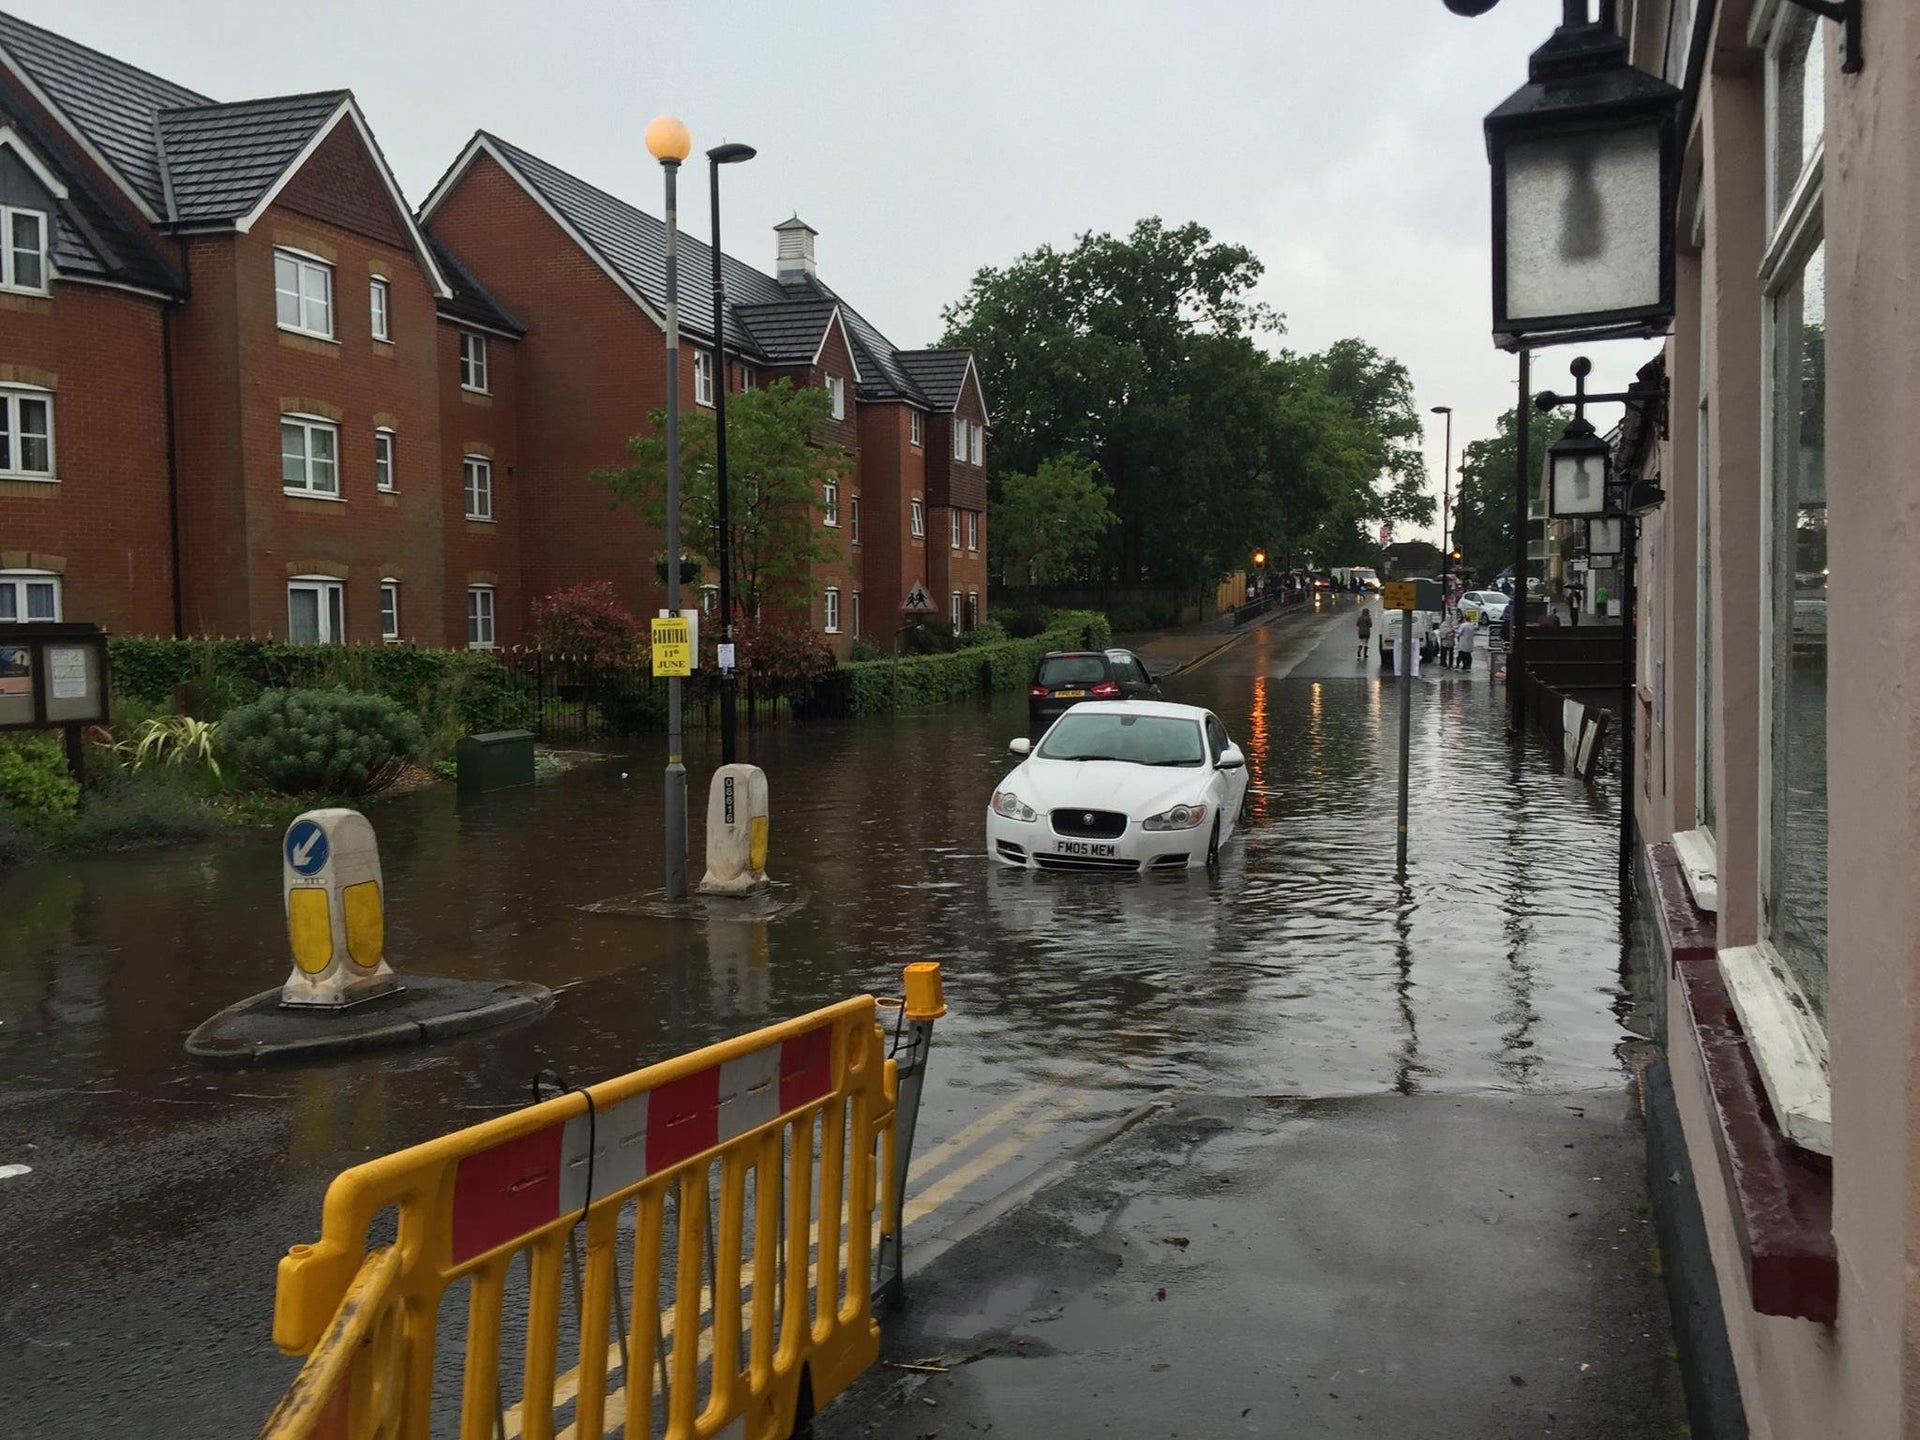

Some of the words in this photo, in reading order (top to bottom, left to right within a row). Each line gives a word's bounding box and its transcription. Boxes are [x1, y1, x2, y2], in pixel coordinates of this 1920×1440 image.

[653, 628, 688, 644] CARNIVAL
[657, 660, 686, 669] JUNE
[725, 778, 734, 823] 08616
[1091, 844, 1115, 857] MEM
